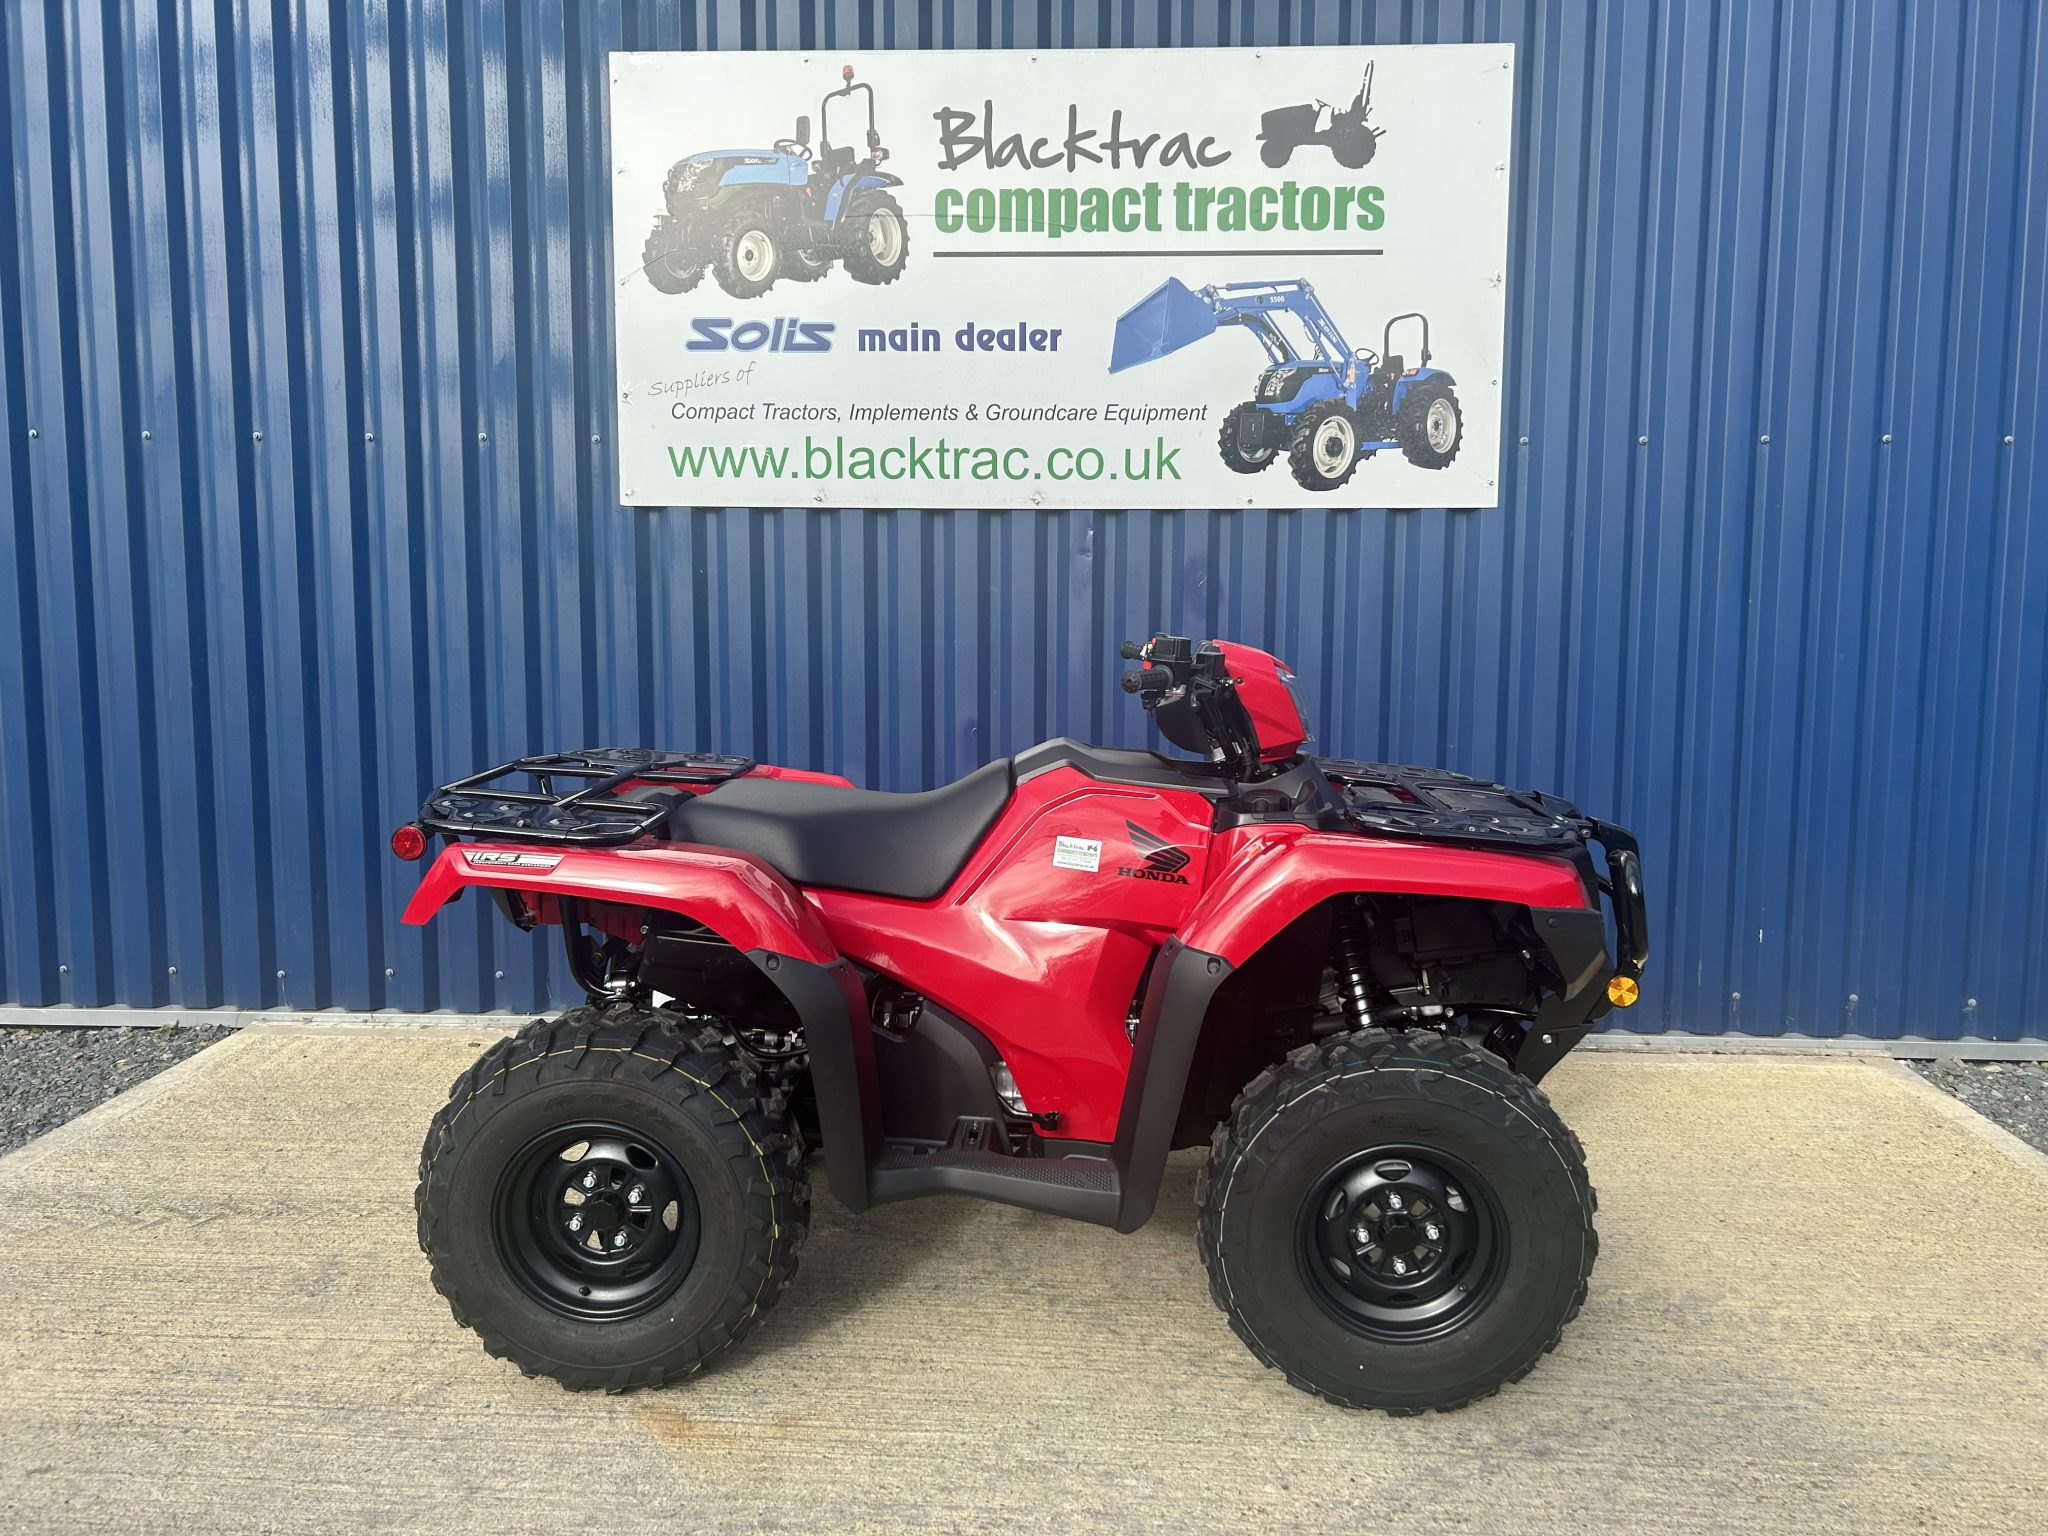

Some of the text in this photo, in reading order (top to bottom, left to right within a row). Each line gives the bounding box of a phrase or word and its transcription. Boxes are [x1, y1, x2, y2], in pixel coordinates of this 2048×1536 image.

[933, 99, 1232, 173] Blacktrac
[934, 181, 1385, 238] compact tractors
[859, 322, 940, 351] main
[955, 322, 1062, 351] dealer
[648, 361, 756, 398] Suppliers of
[672, 403, 1207, 425] Compact Tractors, Implements & Groundcare Equipment
[667, 436, 1182, 480] www.blacktrac.co.uk
[471, 852, 520, 863] IRS
[1117, 866, 1190, 885] HONDA
